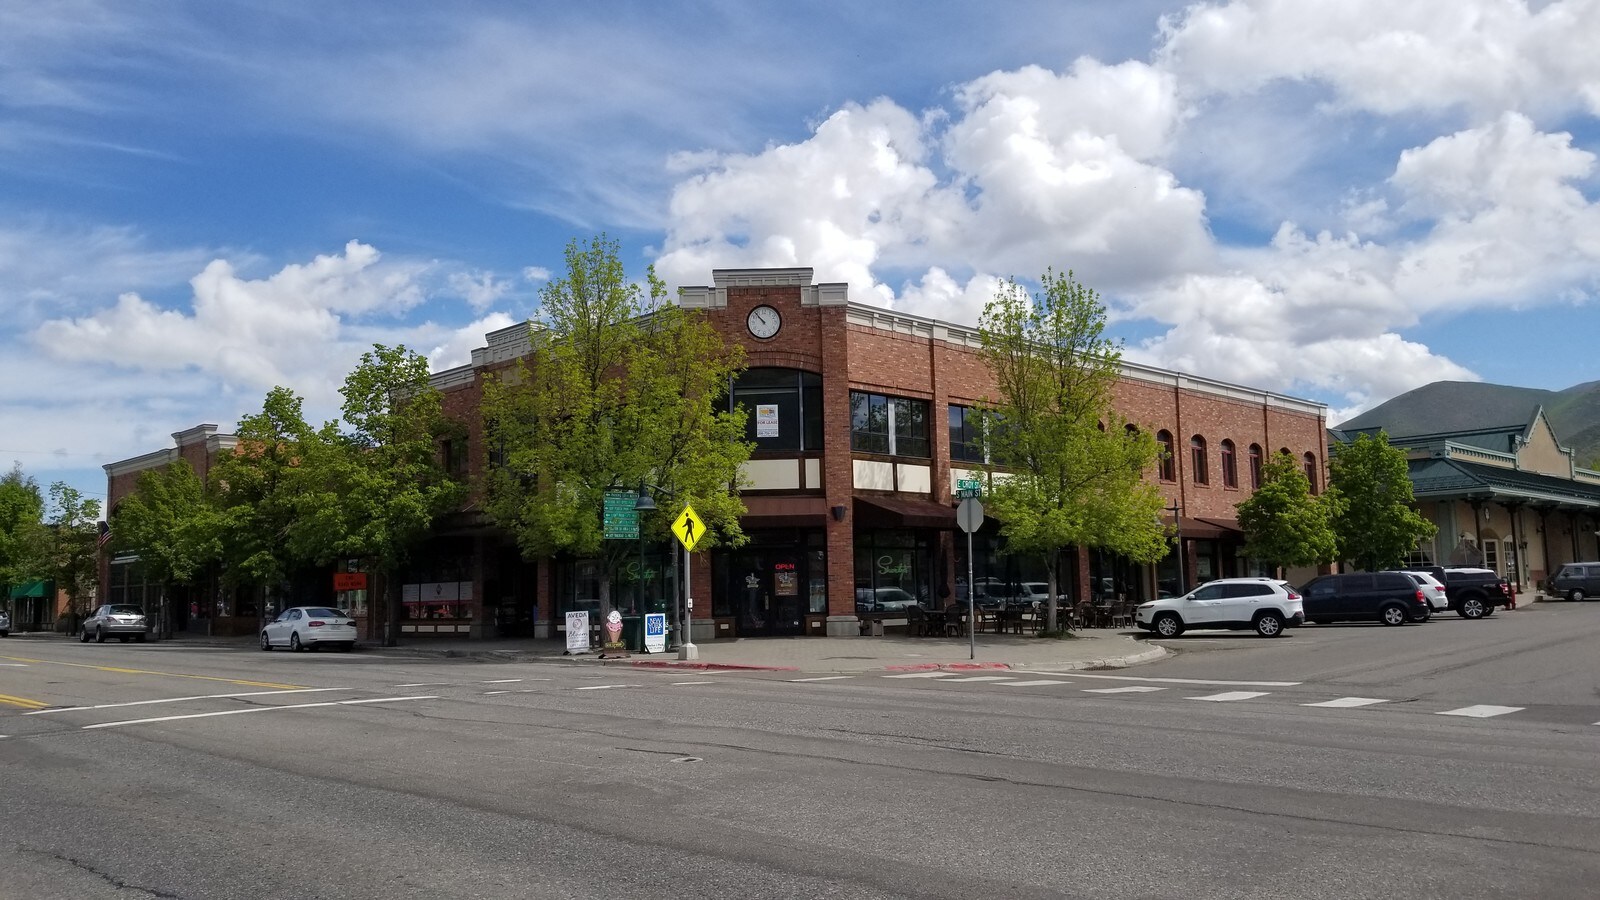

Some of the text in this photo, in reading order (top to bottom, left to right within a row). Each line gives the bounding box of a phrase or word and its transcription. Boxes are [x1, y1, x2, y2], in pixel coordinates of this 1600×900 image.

[962, 480, 974, 489] CROY
[956, 489, 981, 499] S MAIN ST
